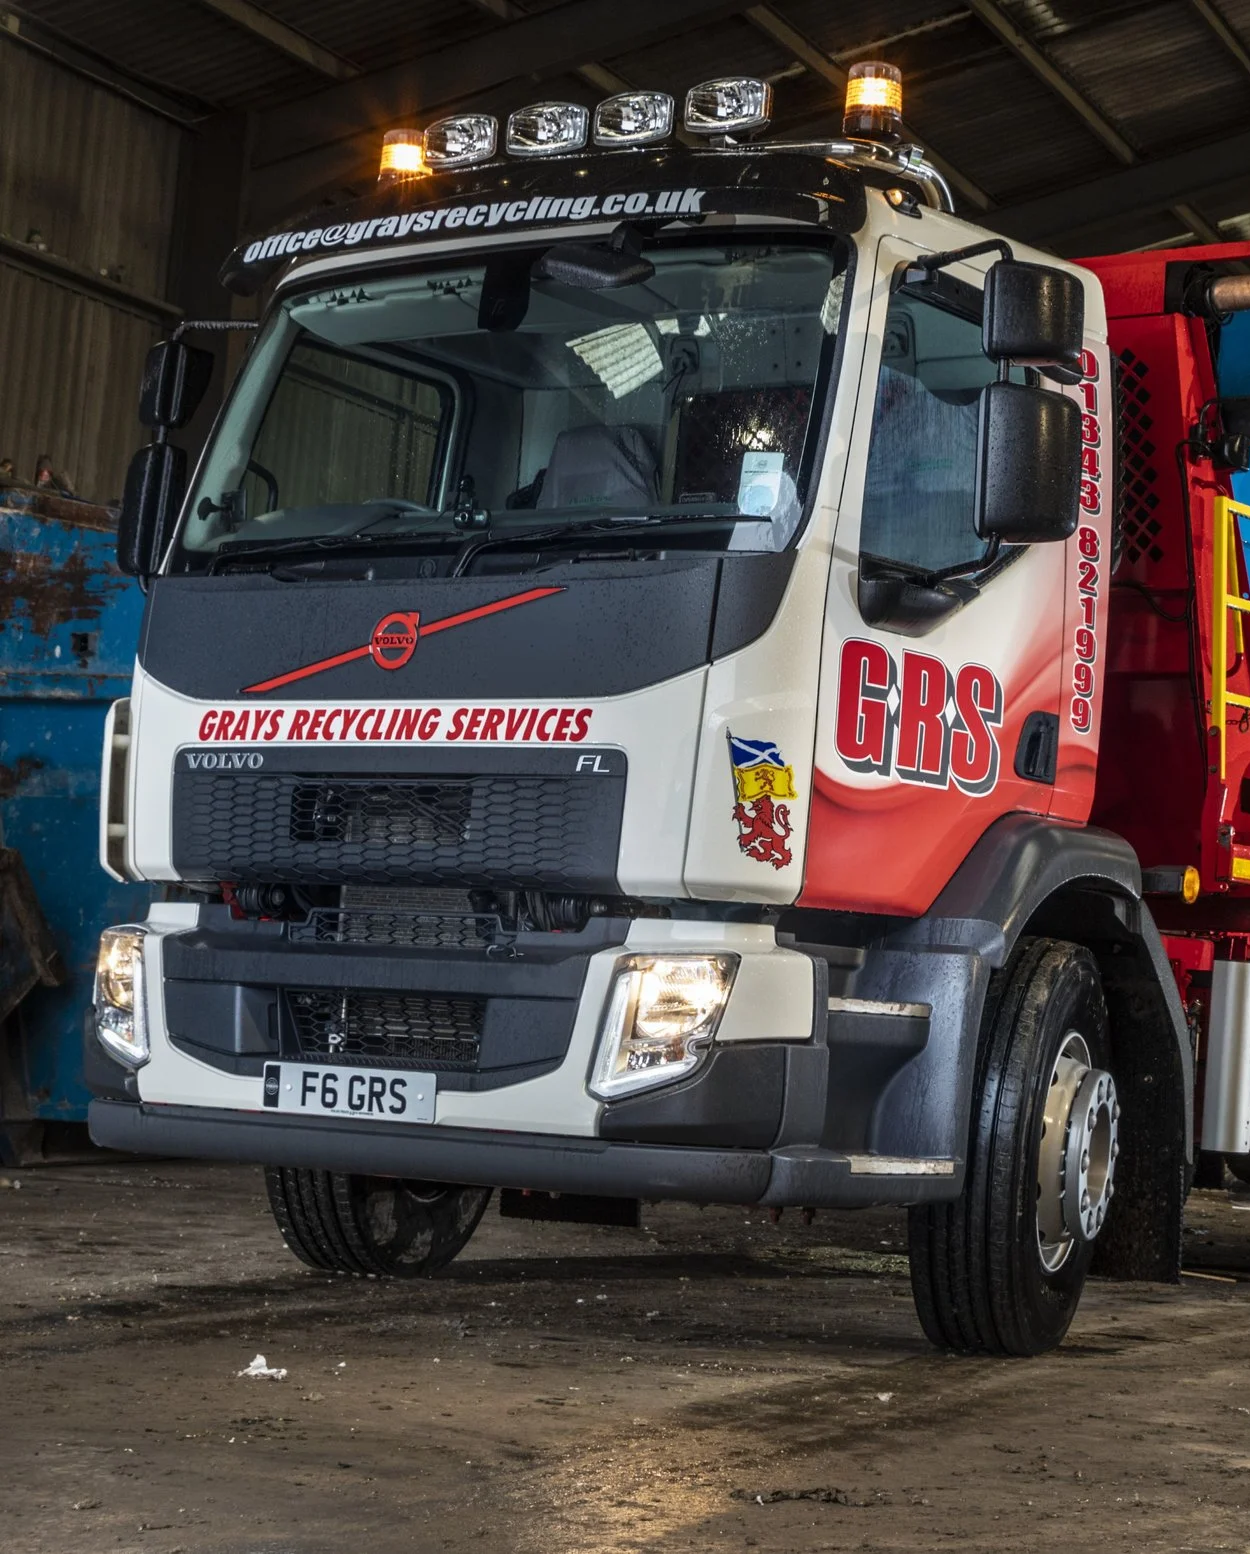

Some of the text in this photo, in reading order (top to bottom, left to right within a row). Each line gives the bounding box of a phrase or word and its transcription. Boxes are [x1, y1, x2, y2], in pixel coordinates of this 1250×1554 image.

[243, 188, 706, 263] office@graysrecycling.co.uk
[374, 636, 414, 645] VOLVO
[1071, 525, 1101, 735] 821999
[198, 707, 593, 742] GRAYS RECYCLING SERVICES
[185, 752, 264, 769] VOLVO
[575, 755, 610, 773] FL
[300, 1071, 408, 1115] F6 GRS
